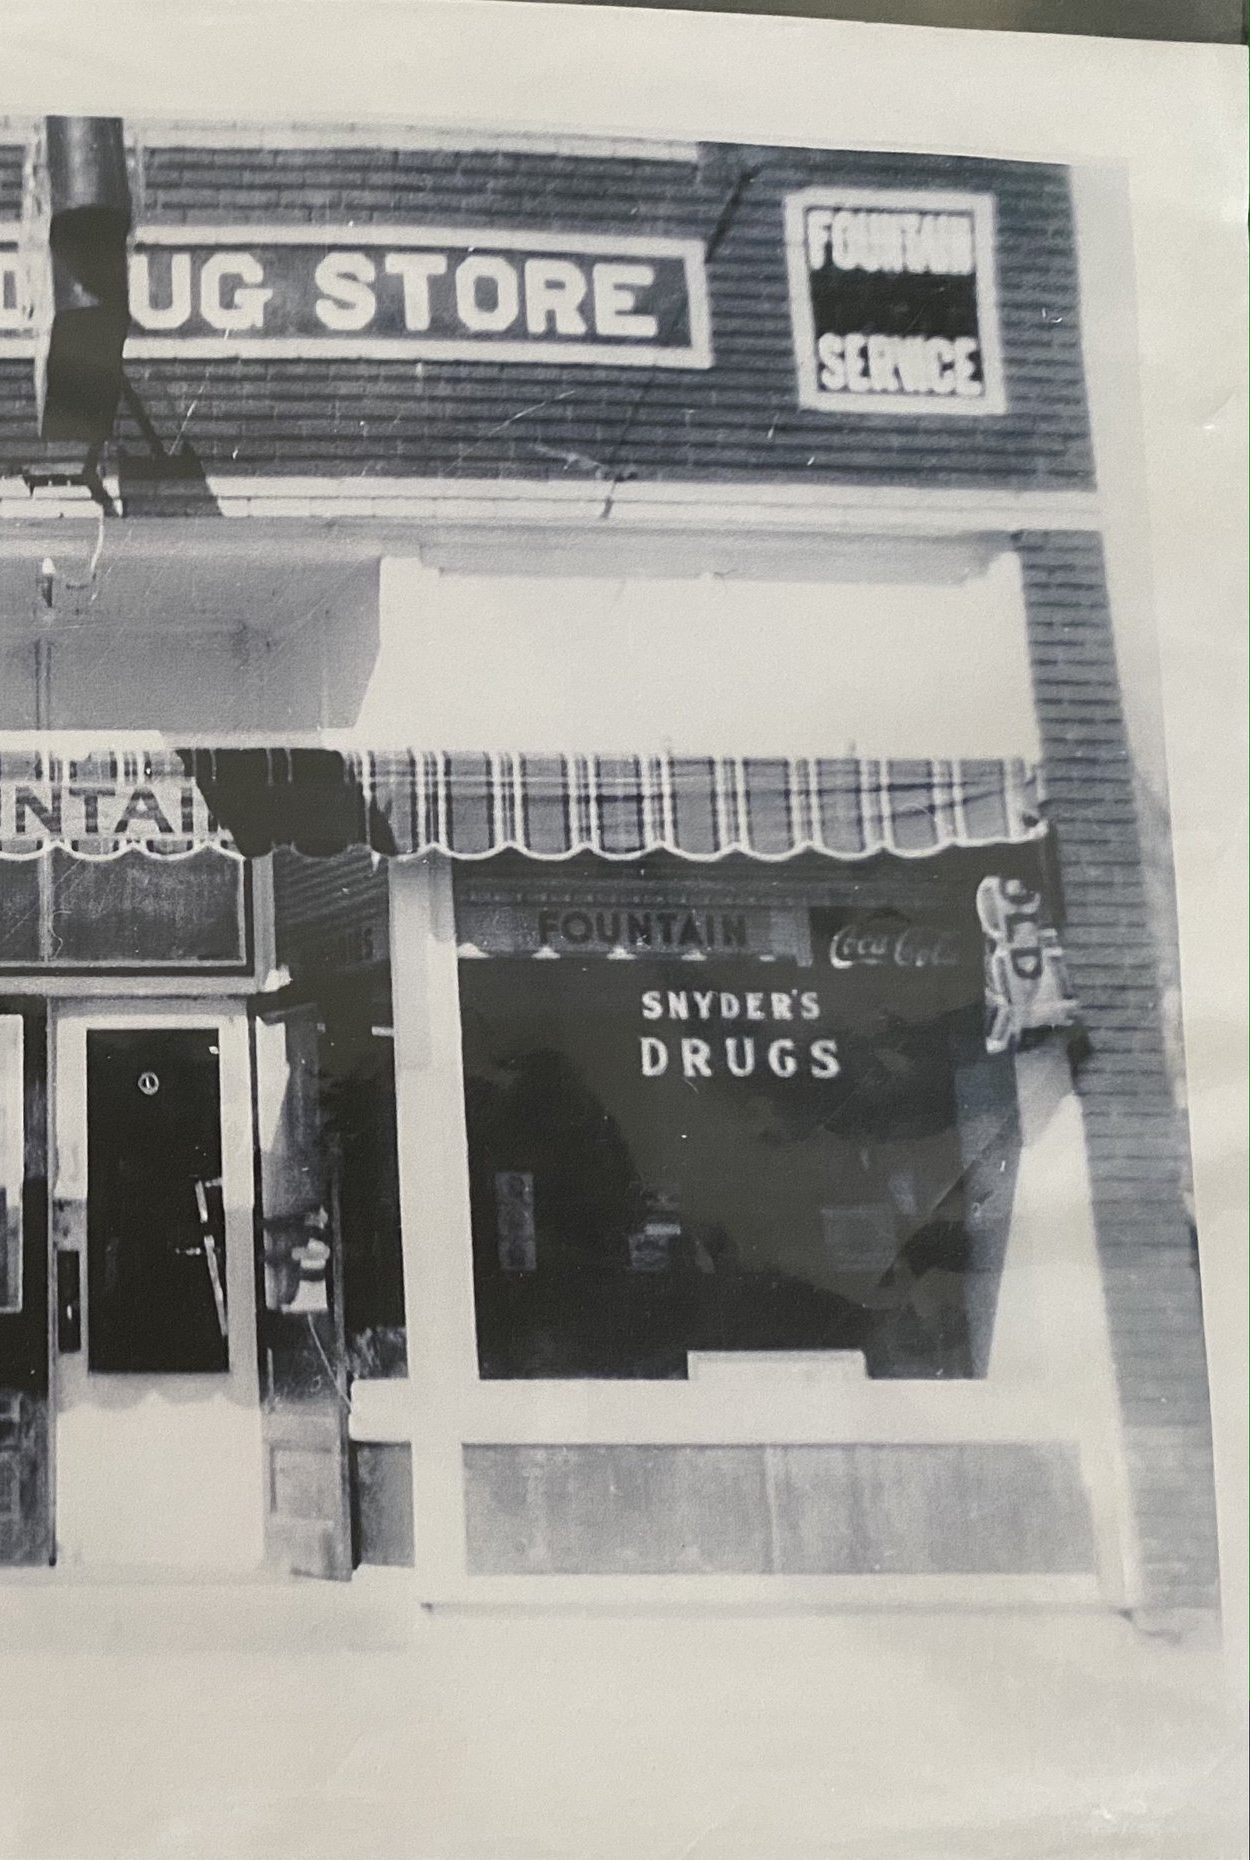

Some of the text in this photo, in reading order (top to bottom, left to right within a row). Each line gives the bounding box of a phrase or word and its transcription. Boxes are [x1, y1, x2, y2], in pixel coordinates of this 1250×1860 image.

[314, 251, 659, 337] STORE
[819, 333, 982, 395] SERVICE
[538, 909, 748, 947] FOUNTAIN
[641, 989, 821, 1020] SNYDER'S
[640, 1036, 841, 1078] DRUGS
